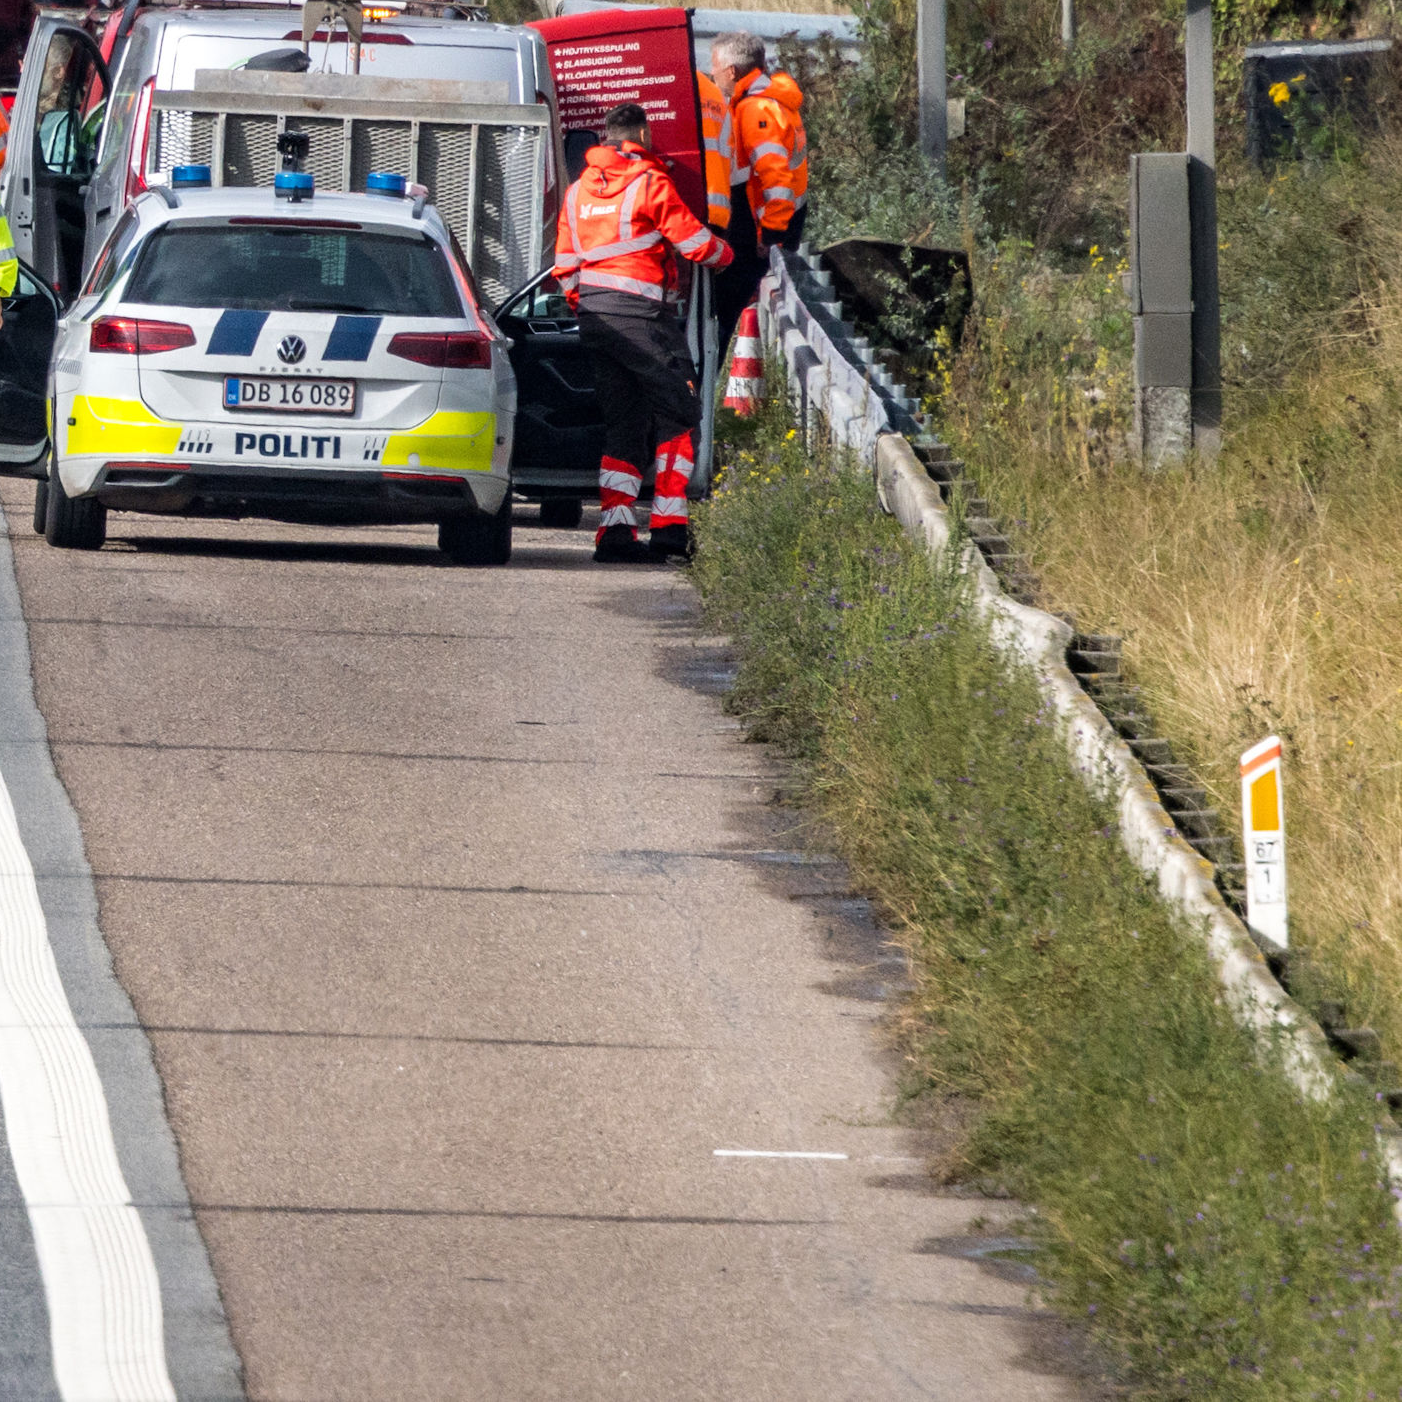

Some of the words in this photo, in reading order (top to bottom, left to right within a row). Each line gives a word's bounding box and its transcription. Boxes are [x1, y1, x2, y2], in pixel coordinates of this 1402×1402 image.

[241, 382, 271, 403] DB
[279, 383, 304, 405] 16
[310, 383, 351, 406] 089
[234, 431, 342, 459] POLITI
[1256, 841, 1275, 858] 67
